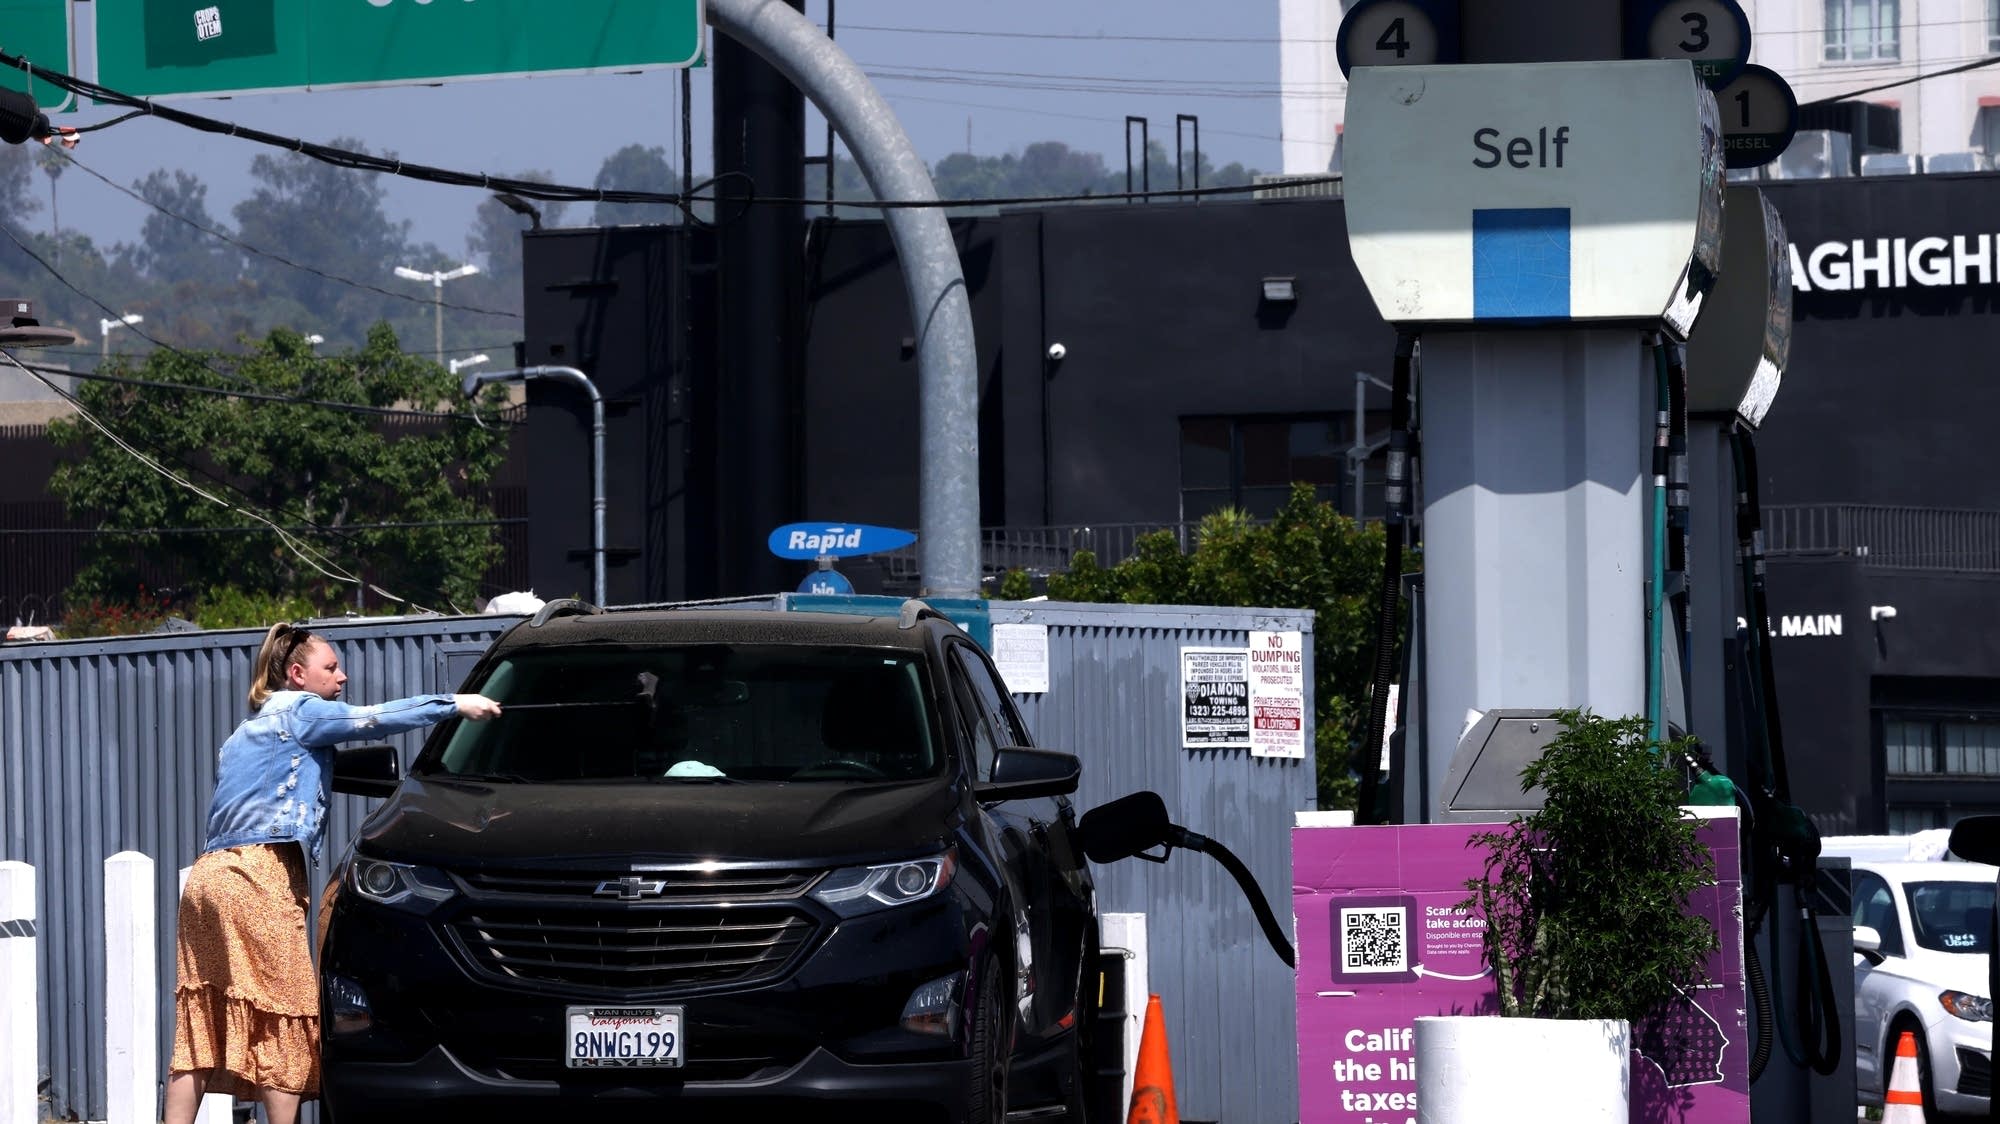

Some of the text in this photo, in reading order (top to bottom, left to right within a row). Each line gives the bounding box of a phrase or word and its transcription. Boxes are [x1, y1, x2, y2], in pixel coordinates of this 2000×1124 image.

[1376, 17, 1410, 58] 4
[1678, 12, 1710, 53] 3
[1735, 89, 1750, 127] 1
[1472, 126, 1570, 169] Self
[788, 528, 862, 554] Rapid
[1781, 615, 1843, 637] MAIN
[1268, 636, 1283, 648] NO
[1252, 650, 1301, 662] DUMPING
[1252, 665, 1301, 673] VIOLATORS WILL BE
[1261, 676, 1293, 684] PROSECUTED
[1200, 683, 1246, 697] DIAMOND
[1209, 697, 1238, 705] TOWING
[1254, 697, 1300, 706] PRIVATE PROPERTY
[1190, 706, 1247, 716] (323) 225-4898
[1254, 707, 1300, 718] NO TRESPASSING
[1258, 718, 1266, 728] NO
[1267, 718, 1297, 729] LOITERING
[1426, 906, 1467, 916] Scan to
[1426, 918, 1450, 929] take
[1426, 932, 1460, 940] Disponible
[1944, 939, 1977, 947] Uber
[592, 1016, 661, 1030] California
[575, 1032, 675, 1057] 8NWG199
[1345, 1028, 1414, 1052] Calif
[575, 1058, 673, 1067] KEYES
[1333, 1058, 1416, 1082] the hi
[1341, 1089, 1417, 1112] taxes
